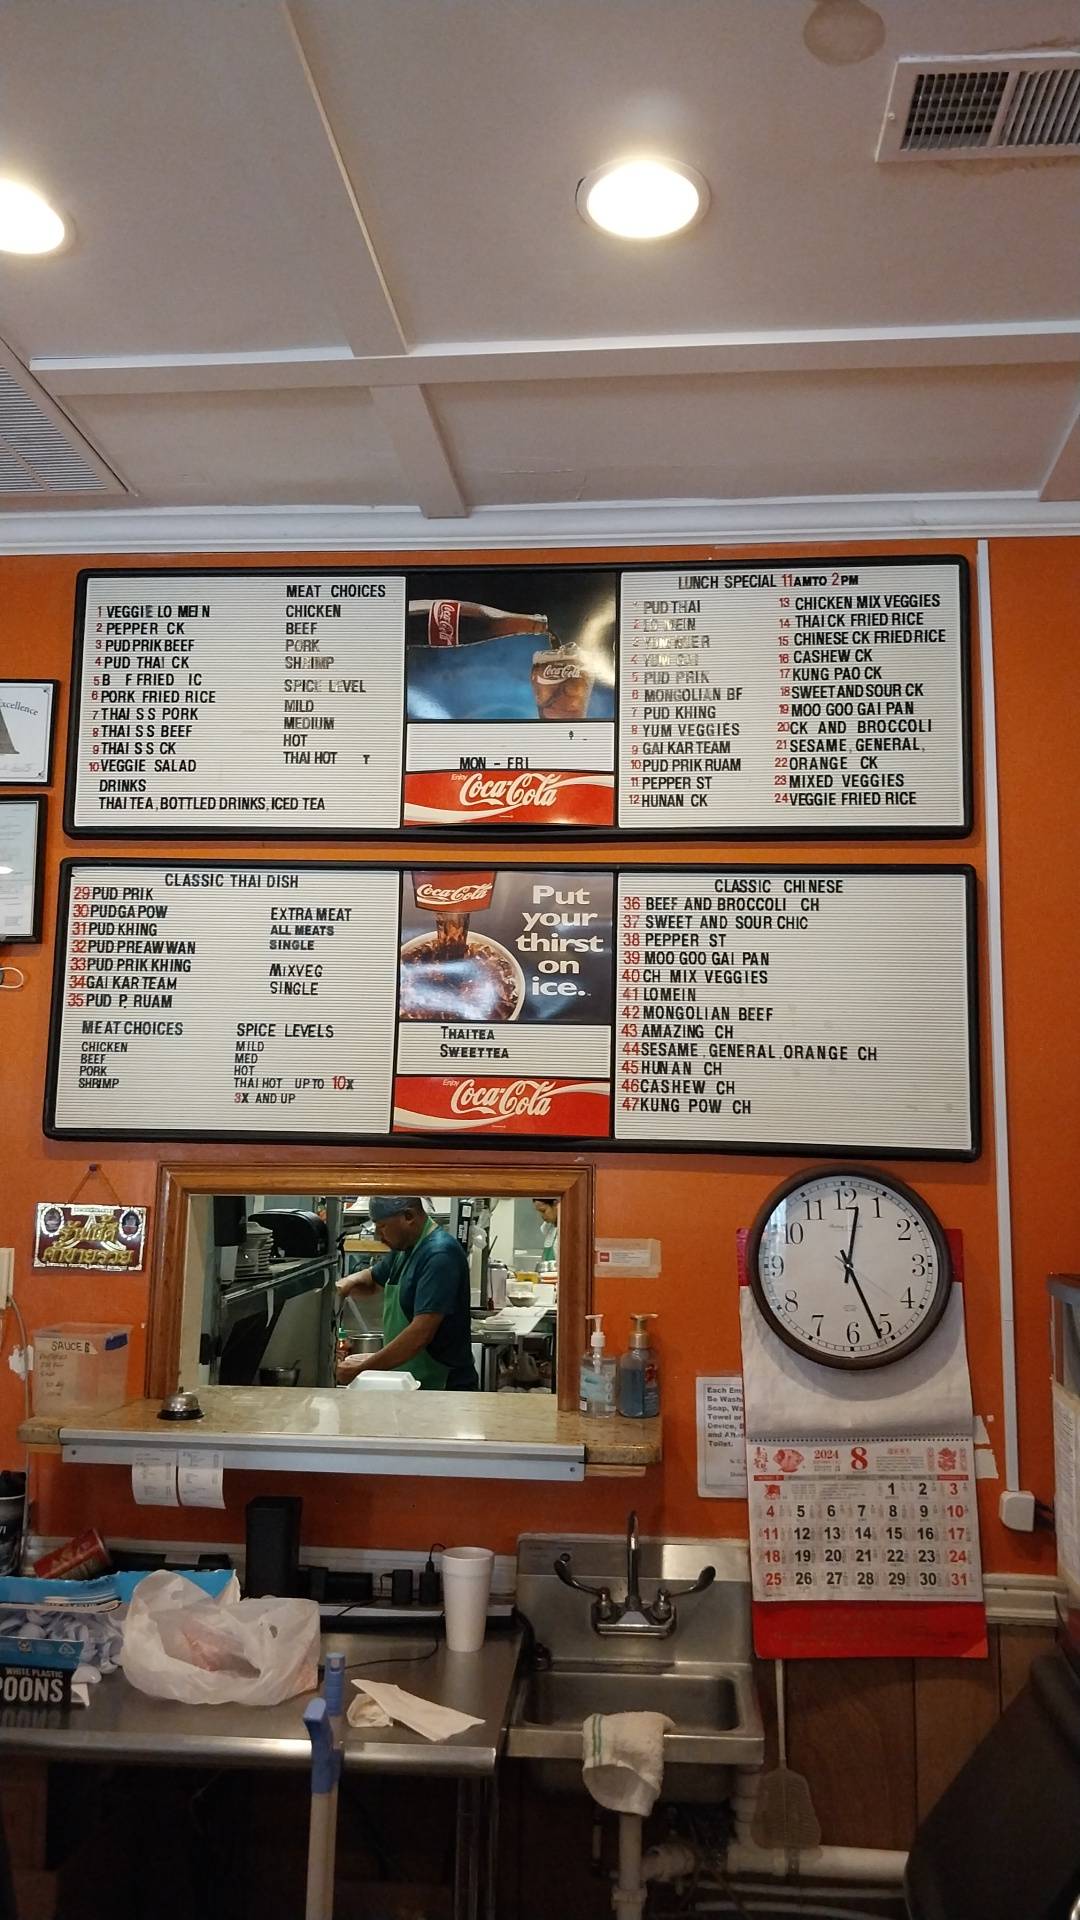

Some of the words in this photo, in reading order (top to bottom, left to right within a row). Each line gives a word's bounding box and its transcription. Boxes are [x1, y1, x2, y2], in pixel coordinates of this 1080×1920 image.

[678, 576, 719, 589] LUNCH
[724, 575, 777, 588] SPECIAL
[286, 585, 322, 597] MEAT
[330, 585, 386, 597] CHOICES
[779, 597, 790, 607] 13
[795, 596, 853, 610] CHICKEN
[856, 596, 881, 608] MIX
[883, 594, 941, 607] VEGGIES
[285, 605, 341, 617] CHICKEN
[96, 623, 103, 633] 2
[106, 623, 158, 635] PEPPER
[166, 622, 185, 634] CK
[285, 622, 318, 634] BEEF
[779, 669, 791, 679] 17
[792, 668, 830, 681] KUNG
[834, 667, 861, 680] PAO
[864, 667, 882, 679] CK
[91, 690, 98, 701] 6
[100, 691, 135, 703] PORK
[142, 691, 180, 703] FRIED
[185, 691, 216, 703] RICE
[0, 701, 38, 715] xcellence
[284, 700, 314, 712] MILD
[643, 707, 670, 719] PUD
[675, 706, 716, 719] KHING
[283, 717, 335, 729] MEDIUM
[642, 724, 672, 737] YUM
[678, 723, 740, 736] VEGGIES
[283, 734, 306, 746] HOT
[89, 761, 99, 773] 10
[100, 759, 146, 772] VEGGIE
[154, 760, 197, 772] SALAD
[460, 757, 486, 769] MON
[508, 757, 528, 769] FRI
[774, 757, 788, 769] 22
[789, 757, 848, 770] ORANGE
[860, 756, 878, 769] CK
[99, 779, 147, 792] DRINKS
[460, 773, 561, 806] Coca-Cola
[629, 795, 640, 805] 12
[641, 794, 684, 807] HUNAN
[690, 794, 708, 806] CK
[774, 793, 789, 804] 24
[789, 793, 837, 805] VEGGIE
[841, 792, 881, 805] FRIED
[885, 792, 917, 805] RICE
[164, 873, 224, 887] CLASSIC
[230, 875, 261, 887] THAI
[266, 872, 299, 888] DISH
[714, 879, 771, 893] CLASSIC
[783, 880, 843, 893] CHINESE
[74, 887, 90, 899] 29
[92, 887, 119, 900] PUD
[122, 888, 154, 900] PRIK
[416, 883, 493, 905] Coca-Cola
[532, 885, 590, 904] Put
[623, 897, 640, 910] 36
[645, 897, 678, 910] BEEF
[684, 897, 712, 910] AND
[717, 898, 786, 911] BROCCOLI
[800, 898, 820, 911] CH
[270, 907, 313, 920] EXTRA
[316, 908, 352, 921] MEAT
[521, 912, 598, 932] your
[269, 940, 315, 950] SINGLE
[516, 933, 603, 952] thirst
[623, 933, 640, 947] 38
[645, 933, 699, 946] PEPPER
[709, 934, 727, 947] ST
[538, 960, 579, 974] on
[621, 969, 640, 983] 40
[642, 969, 661, 982] CH
[670, 970, 697, 983] MIX
[704, 970, 768, 984] VEGGIES
[269, 981, 319, 995] SINGLE
[531, 976, 585, 996] ice.
[621, 1006, 640, 1020] 42
[643, 1006, 730, 1020] MONGOLIAN
[738, 1008, 773, 1021] BEEF
[237, 1023, 276, 1036] SPICE
[284, 1024, 334, 1038] LEVELS
[81, 1042, 128, 1052] CHICKEN
[235, 1041, 265, 1051] MILD
[80, 1054, 106, 1064] BEEF
[234, 1053, 258, 1063] MED
[79, 1066, 107, 1076] PORK
[233, 1065, 254, 1075] HOT
[78, 1078, 120, 1088] SHRIMP
[621, 1079, 640, 1093] 46
[640, 1079, 706, 1094] CASHEW
[716, 1081, 735, 1094] CH
[443, 1079, 459, 1087] Enjoy
[451, 1079, 556, 1116] Coca-Cola
[622, 1098, 640, 1111] 47
[640, 1098, 680, 1112] KUNG
[688, 1099, 722, 1113] POW
[732, 1100, 751, 1114] CH
[833, 1188, 857, 1210] 12
[803, 1199, 824, 1220] 11
[873, 1197, 883, 1218] 1
[784, 1222, 804, 1244] 10
[896, 1219, 911, 1240] 2
[771, 1255, 784, 1277] 9
[912, 1254, 925, 1276] 3
[784, 1290, 798, 1312] 8
[900, 1287, 915, 1309] 4
[812, 1315, 824, 1336] 7
[878, 1313, 892, 1335] 5
[846, 1322, 860, 1344] 6
[51, 1341, 82, 1351] SAUCE
[814, 1449, 839, 1460] 2024
[851, 1447, 868, 1470] 8
[888, 1483, 896, 1495] 1
[919, 1483, 927, 1495] 2
[950, 1483, 958, 1495] 3
[763, 1527, 779, 1540] 11
[794, 1527, 811, 1540] 12
[824, 1527, 841, 1540] 13
[855, 1527, 872, 1540] 14
[886, 1527, 903, 1540] 15
[917, 1527, 934, 1540] 16
[948, 1527, 965, 1540] 17
[766, 1572, 782, 1586] 25
[796, 1572, 812, 1586] 26
[827, 1572, 843, 1586] 27
[857, 1572, 874, 1586] 28
[889, 1572, 905, 1586] 29
[920, 1572, 937, 1586] 30
[951, 1572, 967, 1586] 31
[6, 1668, 31, 1678] WHITE
[32, 1668, 63, 1678] PLASTIC
